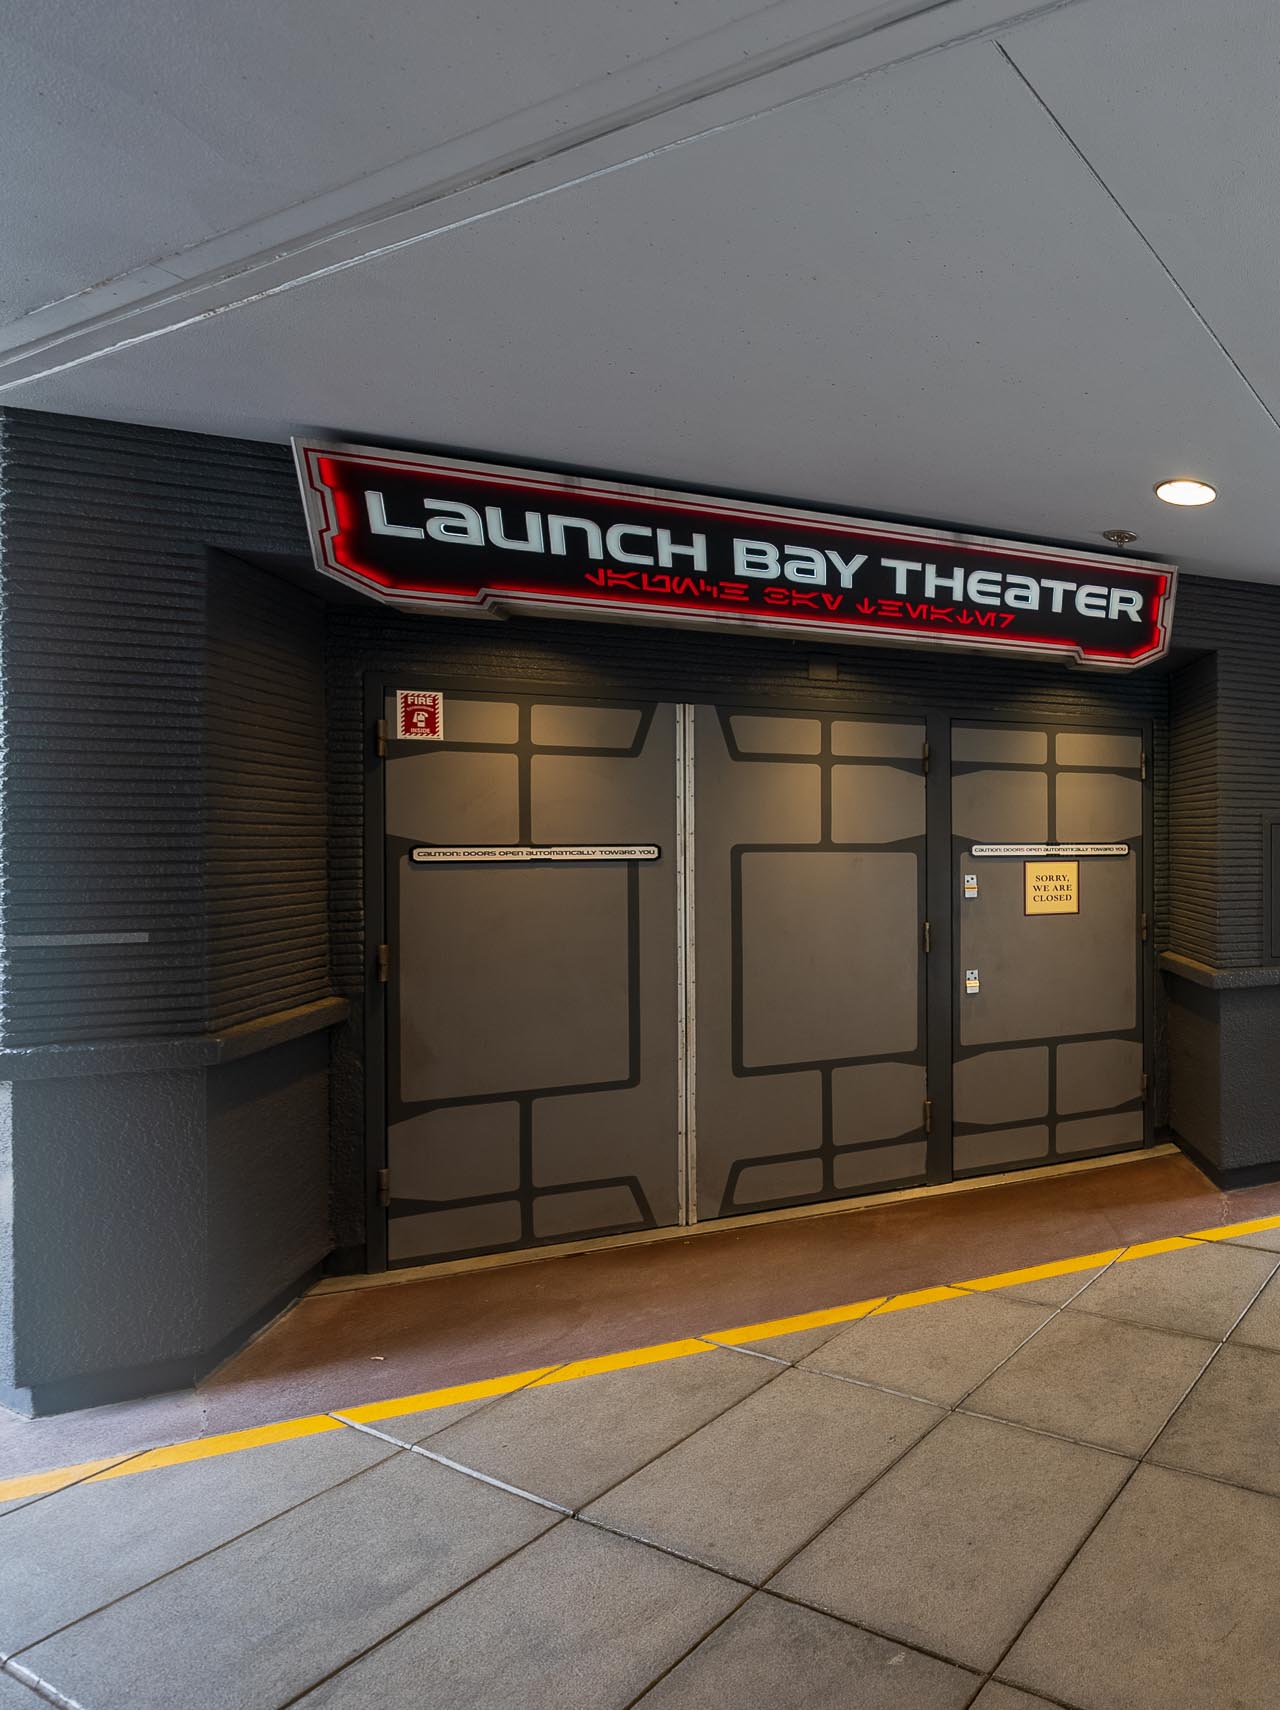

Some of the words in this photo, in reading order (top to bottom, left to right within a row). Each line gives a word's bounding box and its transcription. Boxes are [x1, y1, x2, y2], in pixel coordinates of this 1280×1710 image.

[407, 696, 434, 705] FIRE
[1035, 874, 1070, 882] SORRY,
[1032, 884, 1050, 892] WE
[1053, 884, 1073, 892] ARE
[1033, 894, 1072, 902] CLOSED
